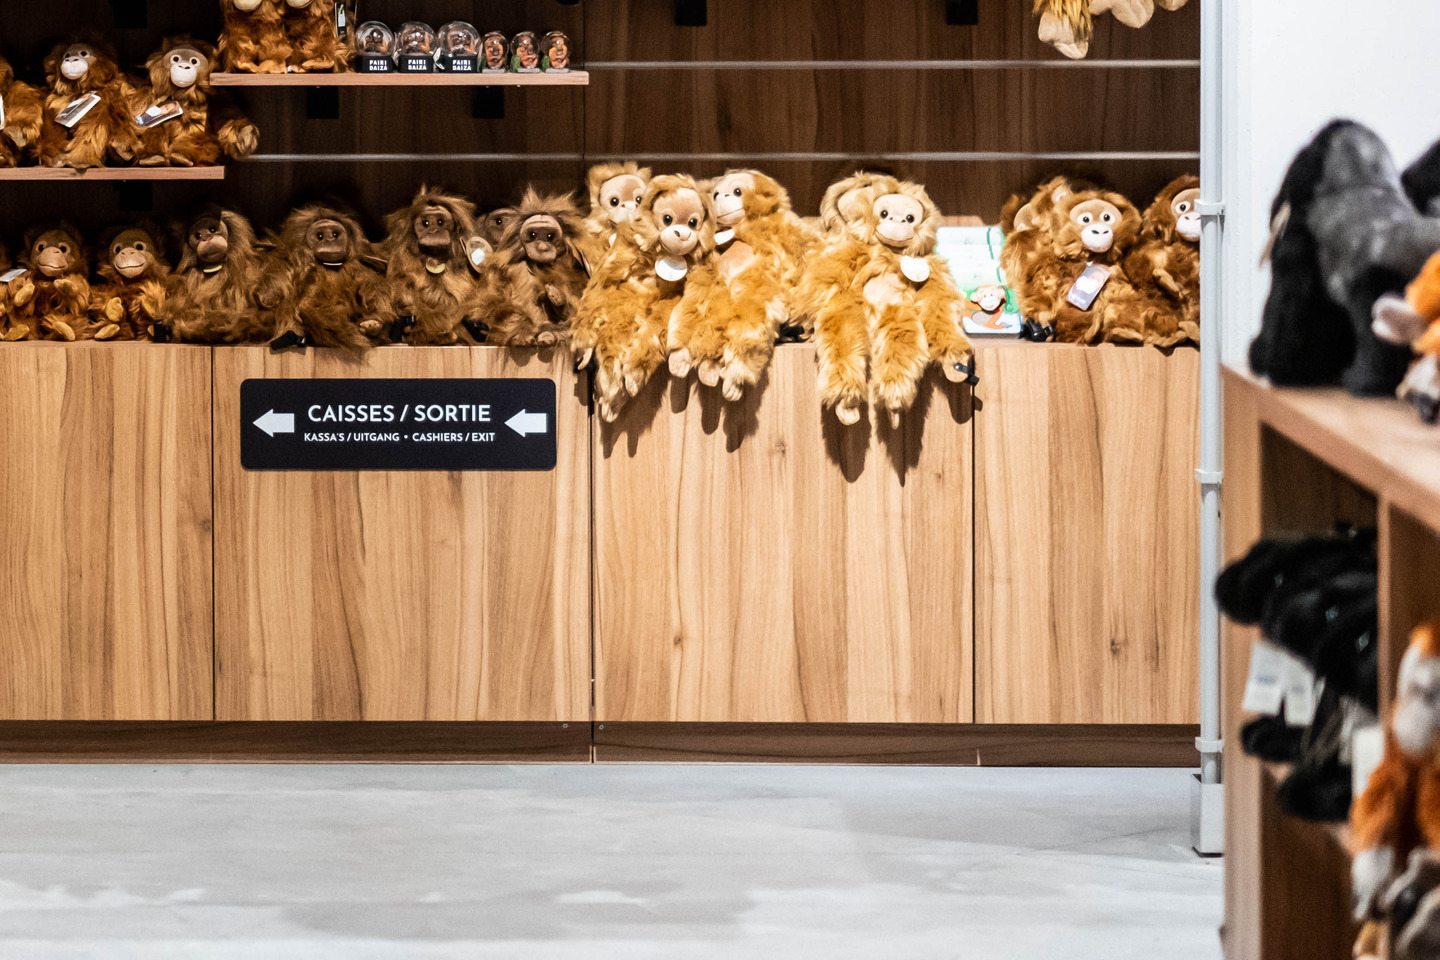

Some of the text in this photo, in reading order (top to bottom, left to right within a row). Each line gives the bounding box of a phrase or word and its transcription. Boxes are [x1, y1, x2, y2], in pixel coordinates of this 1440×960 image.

[307, 404, 394, 423] CAISSES
[413, 404, 491, 422] SORTIE
[304, 432, 345, 442] KASSA'S
[353, 432, 400, 442] UITGANG
[412, 432, 463, 442] CASHIERS
[471, 432, 496, 442] EXIT
